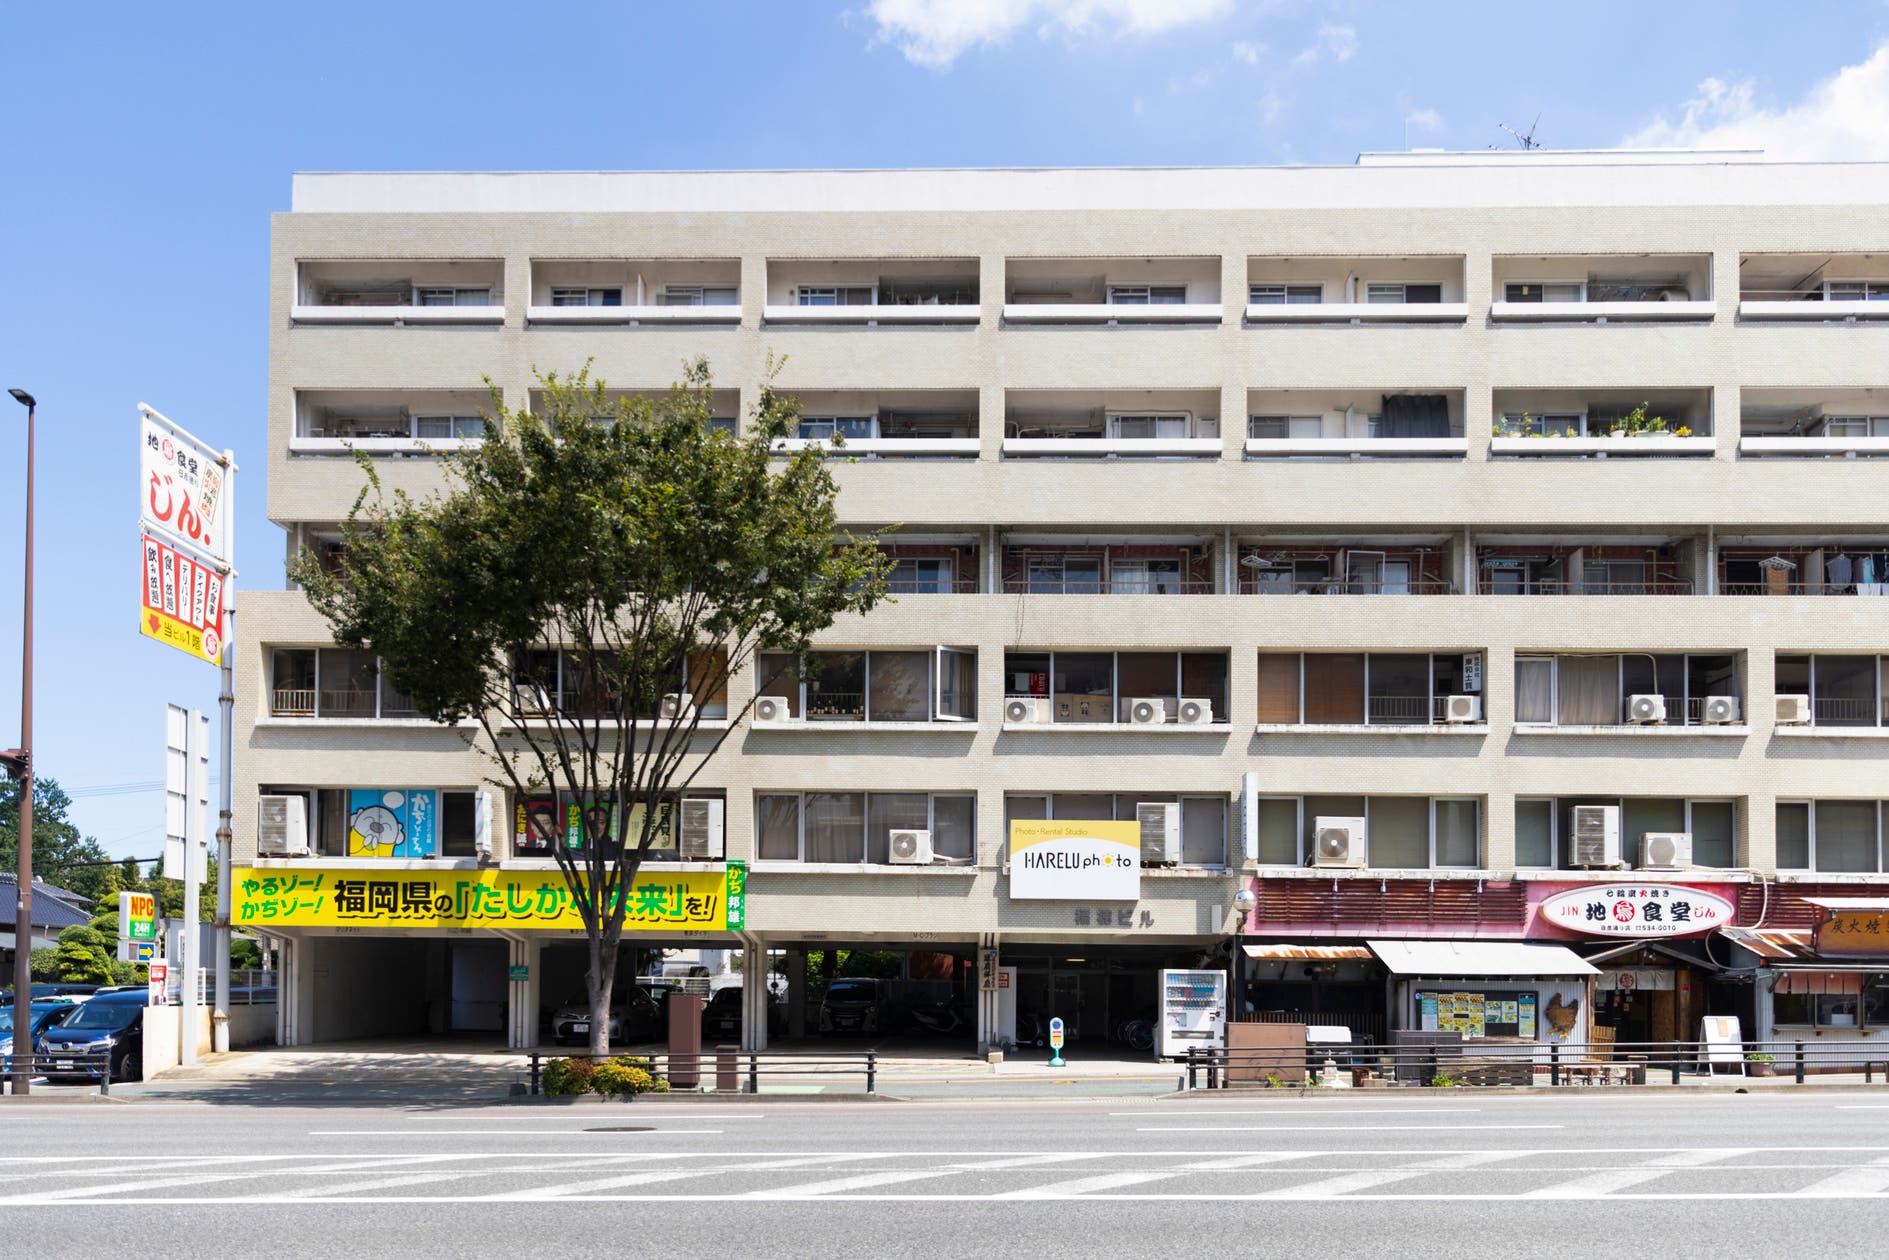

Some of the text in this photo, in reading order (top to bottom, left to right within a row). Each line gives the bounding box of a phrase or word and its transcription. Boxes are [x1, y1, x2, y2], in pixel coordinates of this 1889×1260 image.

[1065, 827, 1089, 836] Studio
[1024, 852, 1080, 869] HARELU
[130, 895, 154, 917] NPC
[134, 922, 150, 932] 24H
